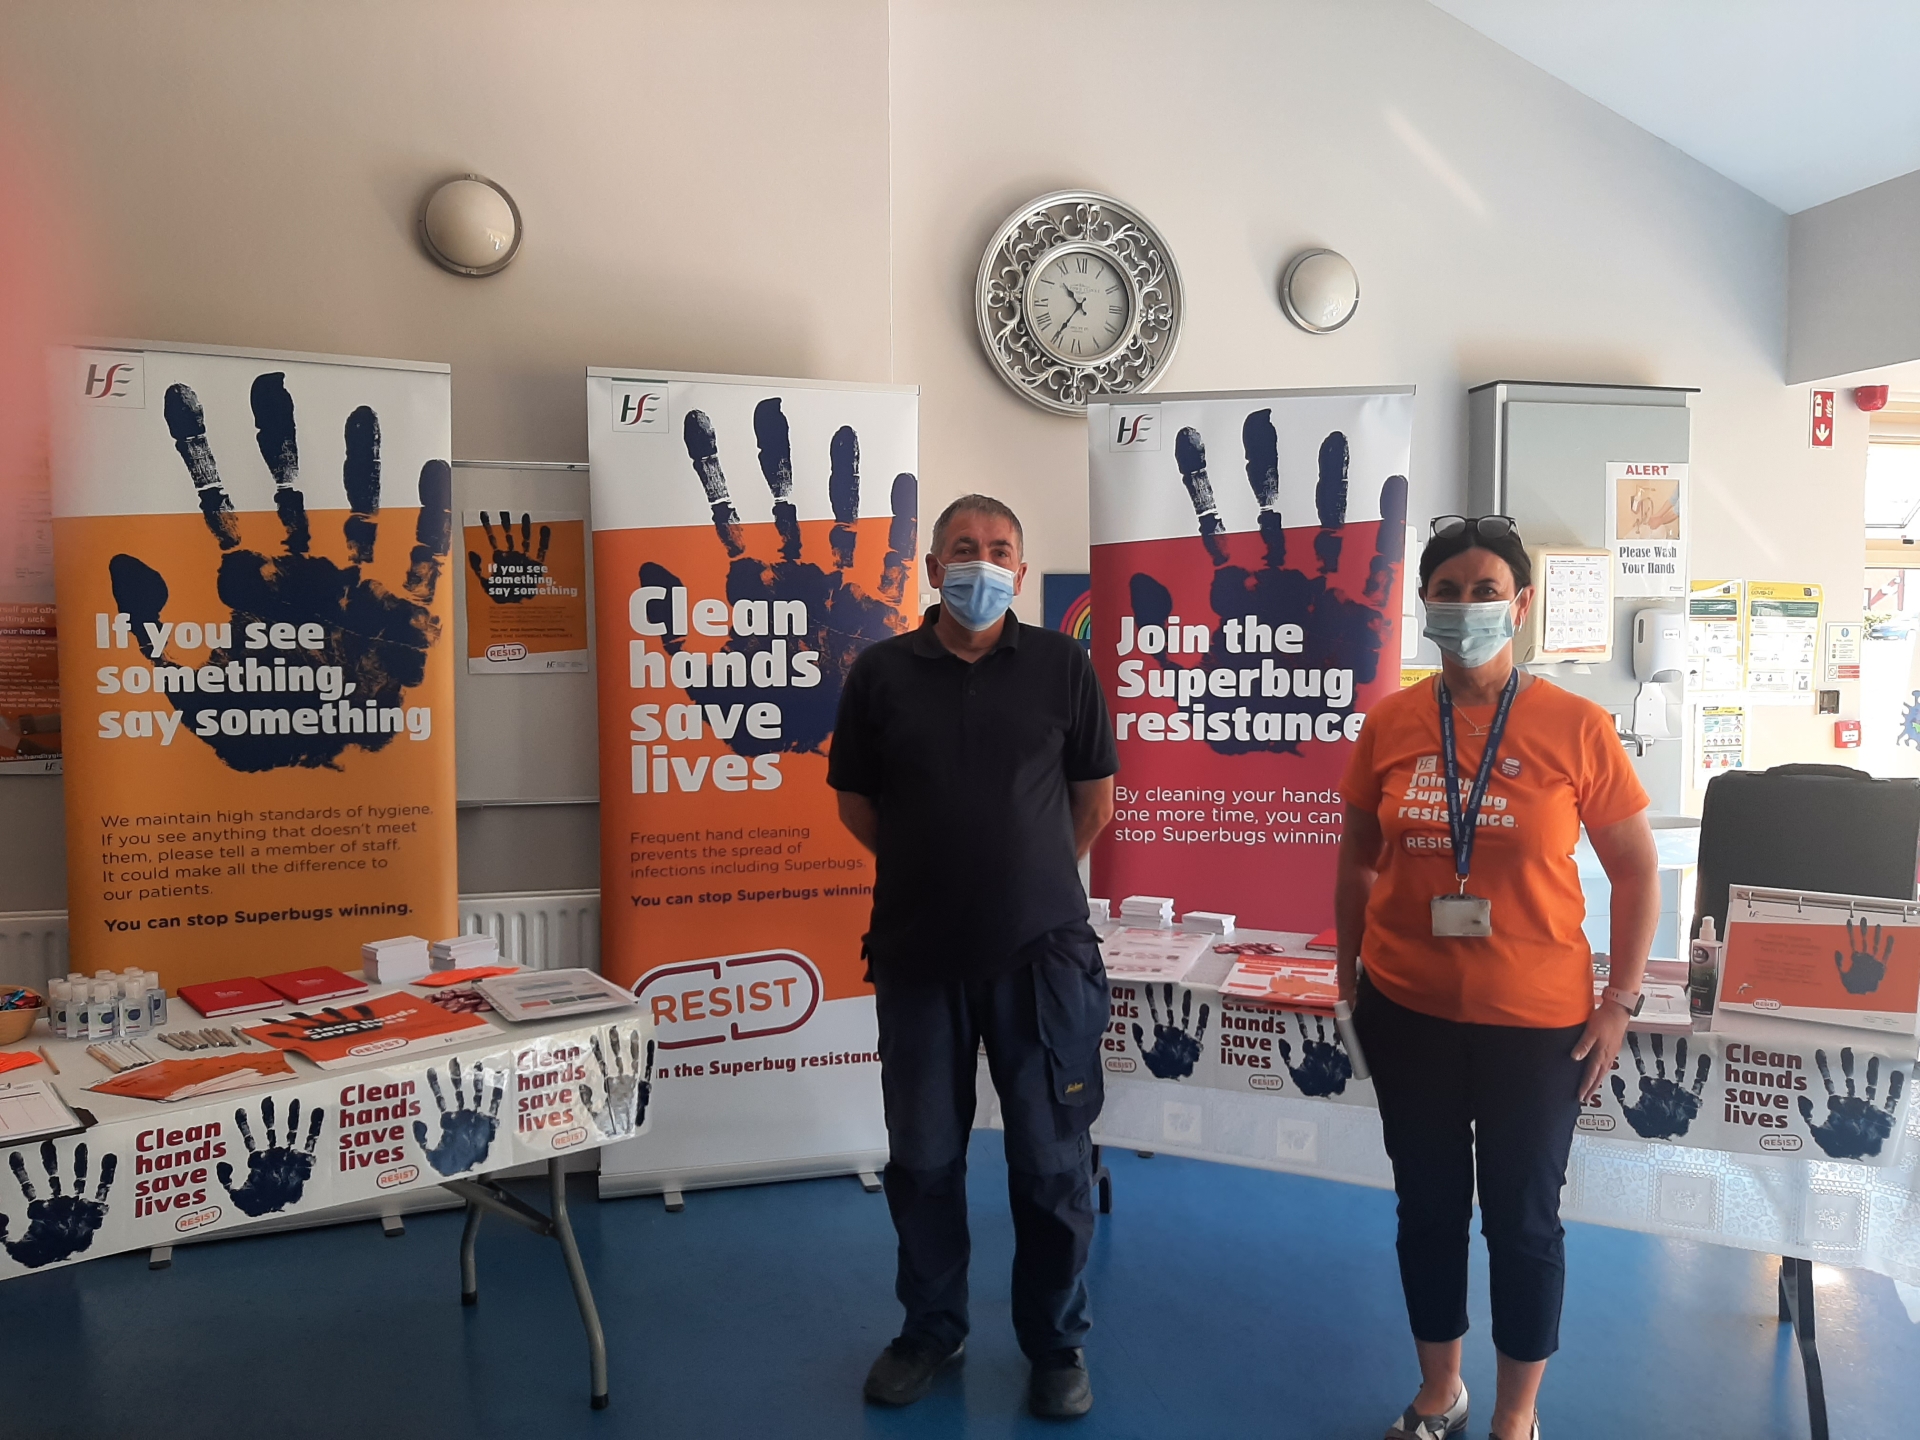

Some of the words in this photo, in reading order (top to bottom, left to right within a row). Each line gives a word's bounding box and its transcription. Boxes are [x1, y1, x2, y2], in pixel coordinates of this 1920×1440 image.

[1625, 465, 1669, 476] ALERT
[1619, 546, 1651, 558] Please
[1654, 546, 1677, 558] Wash
[488, 563, 497, 573] If
[500, 565, 524, 575] you
[527, 564, 548, 573] see
[1622, 562, 1644, 574] Your
[1647, 562, 1676, 574] Hands
[488, 587, 510, 597] say
[513, 586, 578, 597] something
[628, 586, 808, 636] Clean
[95, 613, 132, 649] If
[143, 621, 233, 658] you
[245, 621, 325, 650] see
[1116, 615, 1210, 656] Join
[1223, 615, 1304, 654] the
[490, 648, 522, 657] RESIST
[629, 639, 822, 688] hands
[97, 657, 356, 700] something,
[1116, 659, 1353, 707] Superbug
[98, 709, 184, 746] say
[196, 700, 432, 741] something
[630, 702, 782, 741] save
[1116, 704, 1367, 743] resistance
[631, 745, 783, 794] lives
[1410, 773, 1446, 788] Join
[1115, 786, 1139, 804] By
[1145, 786, 1225, 804] cleaning
[1232, 789, 1276, 805] your
[1282, 787, 1341, 804] hands
[101, 814, 129, 828] We
[136, 810, 211, 826] maintain
[216, 809, 253, 826] high
[259, 805, 341, 821] standards
[346, 805, 362, 818] of
[1115, 809, 1150, 822] one
[1156, 809, 1205, 822] more
[1211, 807, 1259, 825] time,
[1266, 810, 1301, 826] you
[1308, 811, 1342, 824] can
[101, 833, 112, 846] If
[118, 833, 151, 849] you
[157, 831, 186, 843] see
[192, 826, 266, 843] anything
[272, 824, 305, 839] that
[311, 821, 371, 837] doesn't
[377, 821, 417, 834] meet
[630, 831, 700, 845] Frequent
[706, 828, 743, 841] hand
[748, 826, 810, 840] cleaning
[1115, 827, 1156, 844] stop
[1162, 826, 1266, 846] Superbugs
[1406, 837, 1452, 848] RESIS
[102, 850, 152, 865] them,
[158, 847, 213, 863] please
[219, 845, 245, 858] tell
[251, 847, 260, 857] a
[266, 841, 334, 856] member
[340, 840, 357, 852] of
[631, 848, 697, 863] prevents
[702, 845, 726, 858] the
[732, 843, 782, 859] spread
[787, 842, 803, 854] of
[103, 870, 115, 883] It
[120, 867, 169, 882] could
[175, 864, 221, 879] make
[227, 862, 245, 876] all
[251, 861, 278, 874] the
[284, 857, 366, 873] difference
[372, 857, 388, 869] to
[630, 864, 706, 879] infections
[711, 860, 779, 875] including
[103, 889, 133, 901] our
[139, 883, 213, 900] patients.
[631, 895, 660, 907] You
[666, 894, 693, 905] can
[698, 889, 732, 905] stop
[737, 886, 818, 902] Superbugs
[823, 884, 872, 897] winnin
[104, 917, 141, 933] You
[147, 915, 181, 929] can
[187, 911, 228, 928] stop
[235, 905, 333, 924] Superbugs
[339, 902, 413, 918] winning.
[651, 977, 797, 1026] RESIST
[303, 1022, 359, 1035] Clean
[360, 1008, 418, 1023] hands
[310, 1027, 357, 1039] save
[360, 1017, 406, 1029] lives
[1220, 1012, 1285, 1035] hands
[355, 1039, 400, 1055] RESIST
[1220, 1033, 1271, 1051] save
[516, 1046, 580, 1071] Clean
[674, 1063, 704, 1078] the
[709, 1056, 796, 1076] Superbug
[801, 1051, 880, 1068] resistanc
[1220, 1047, 1271, 1069] lives
[1725, 1043, 1802, 1070] Clean
[517, 1063, 586, 1092] hands
[1252, 1077, 1280, 1087] RESIST
[1725, 1064, 1807, 1091] hands
[340, 1080, 415, 1107] Clean
[518, 1087, 573, 1113] save
[1725, 1087, 1789, 1110] save
[340, 1098, 421, 1128] hands
[518, 1108, 574, 1134] lives
[1579, 1118, 1613, 1128] RESIST
[1724, 1103, 1788, 1129] lives
[135, 1122, 221, 1152] Clean
[339, 1125, 404, 1150] save
[555, 1131, 585, 1147] RESIST
[1763, 1138, 1798, 1147] RESIST
[135, 1140, 227, 1175] hands
[340, 1145, 404, 1172] lives
[135, 1167, 207, 1197] save
[380, 1169, 415, 1185] RESIST
[135, 1187, 207, 1218] lives
[180, 1210, 217, 1228] RESIST
